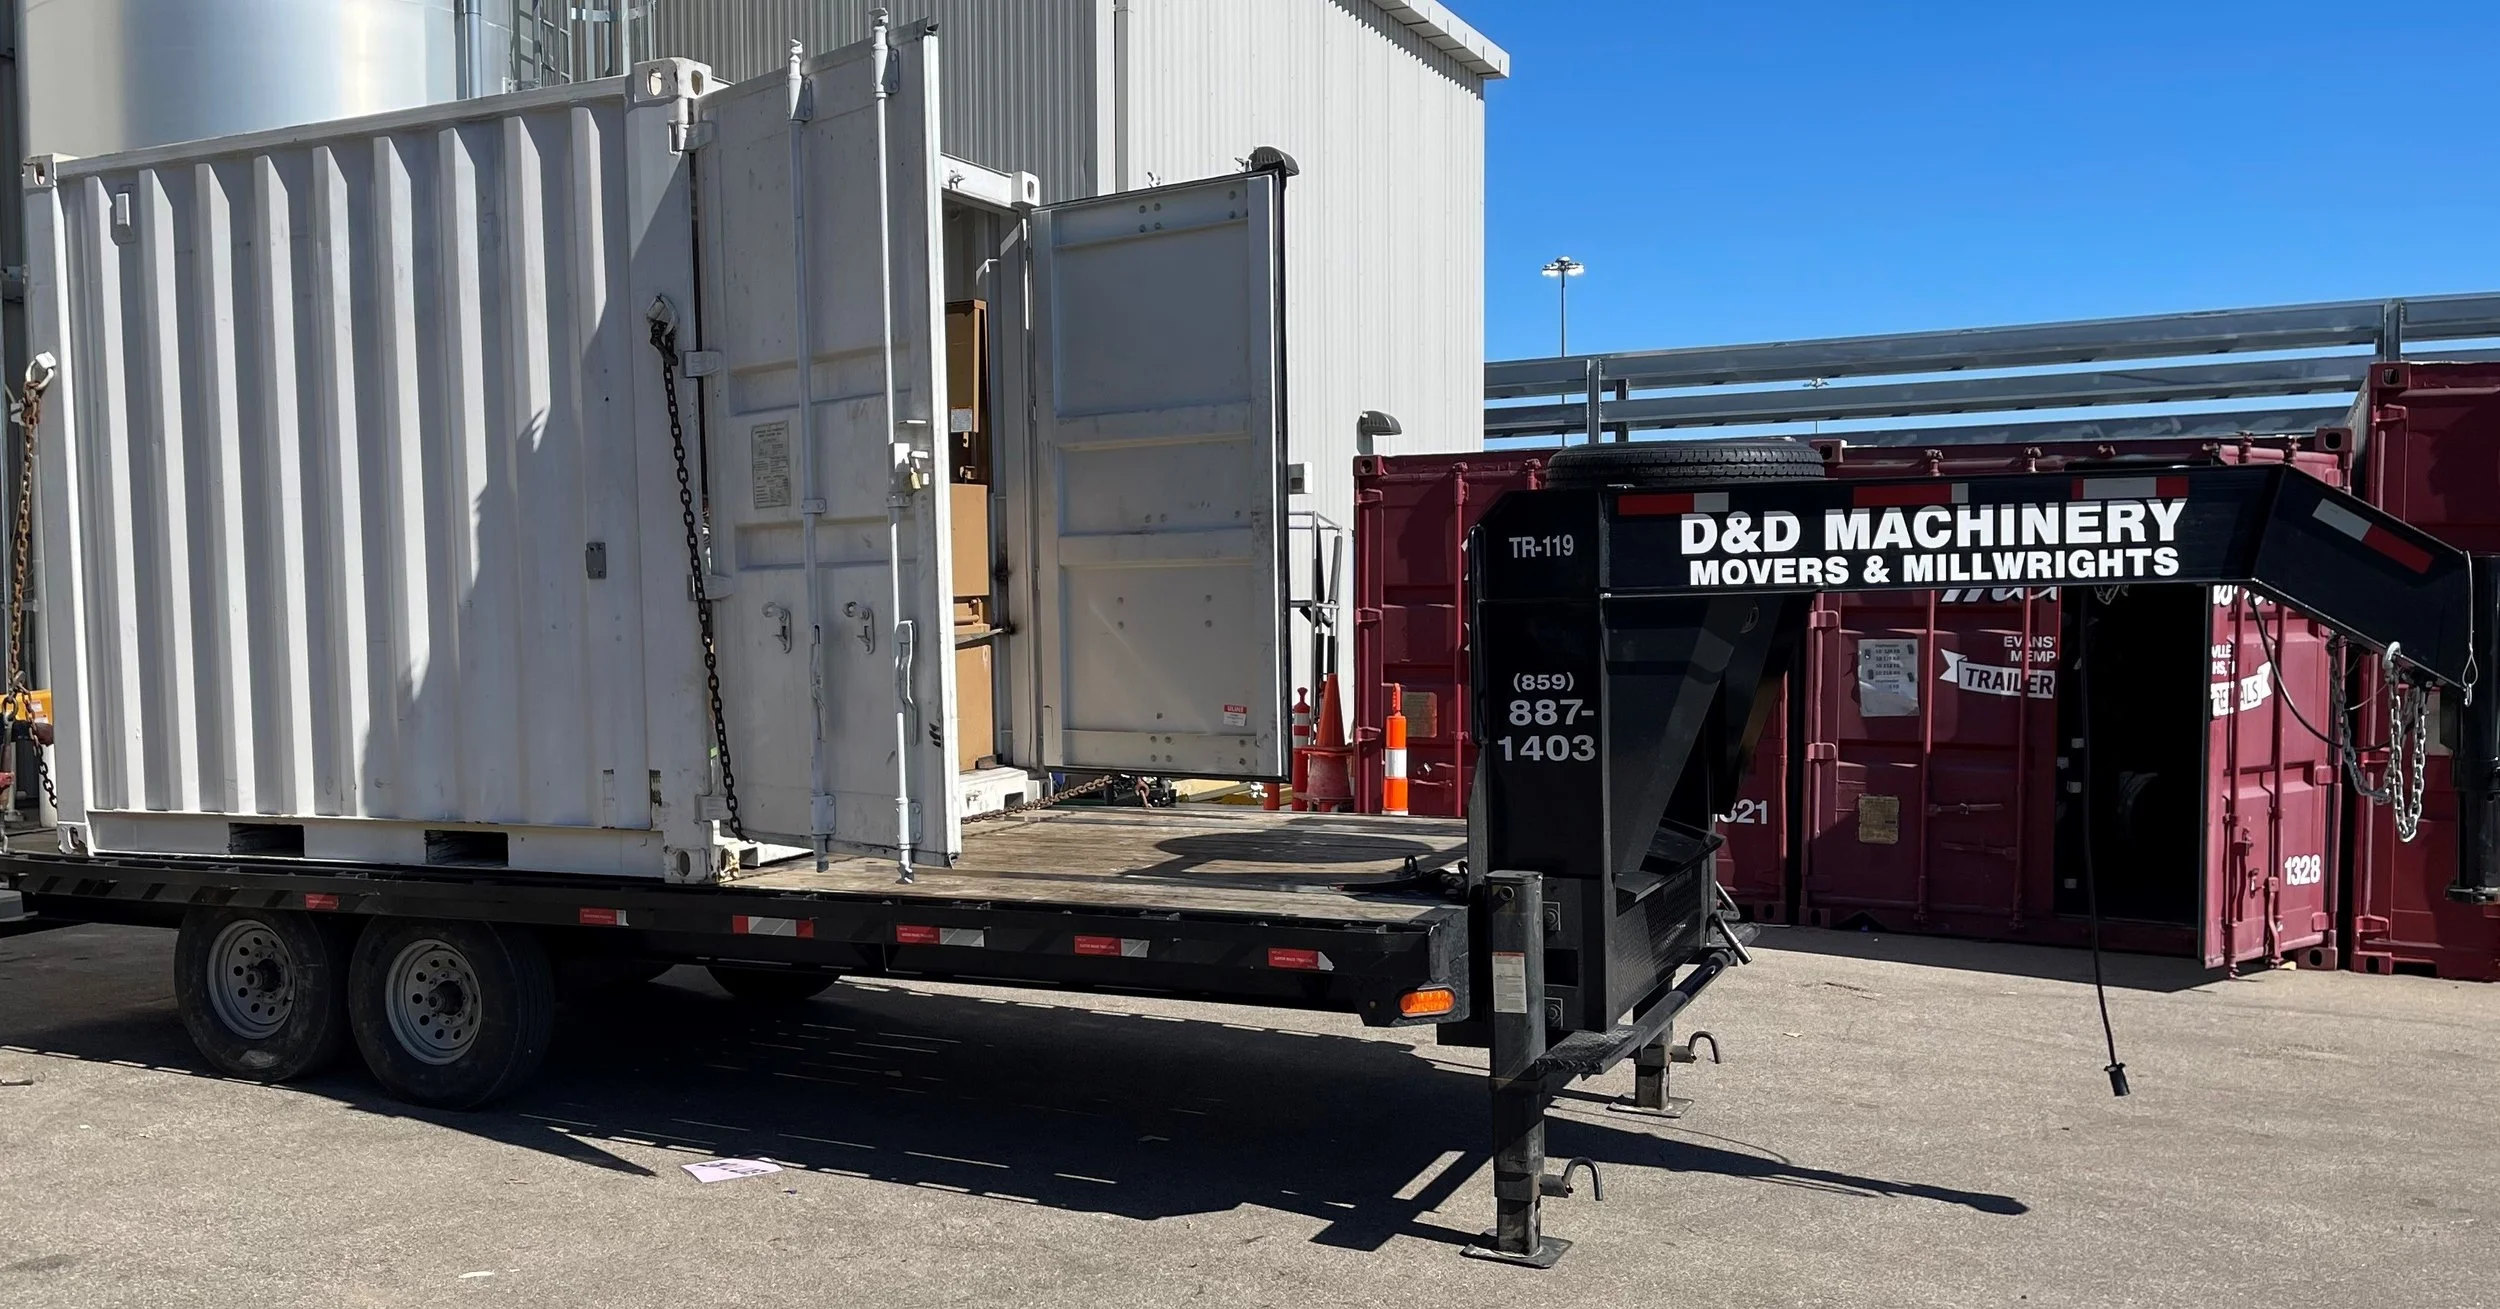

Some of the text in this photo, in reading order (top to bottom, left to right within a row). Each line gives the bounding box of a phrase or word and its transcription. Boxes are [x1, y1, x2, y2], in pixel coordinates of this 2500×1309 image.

[1681, 498, 2188, 555] D&D MACHINERY
[1508, 534, 1574, 559] TR-119
[1689, 546, 2180, 586] MOVERS & MILLWRIGHTS
[1513, 672, 1574, 693] (859)
[1965, 667, 2053, 695] TRAILER
[1508, 698, 1594, 727] 887-
[1497, 734, 1596, 762] 1403
[2284, 854, 2321, 886] 1328
